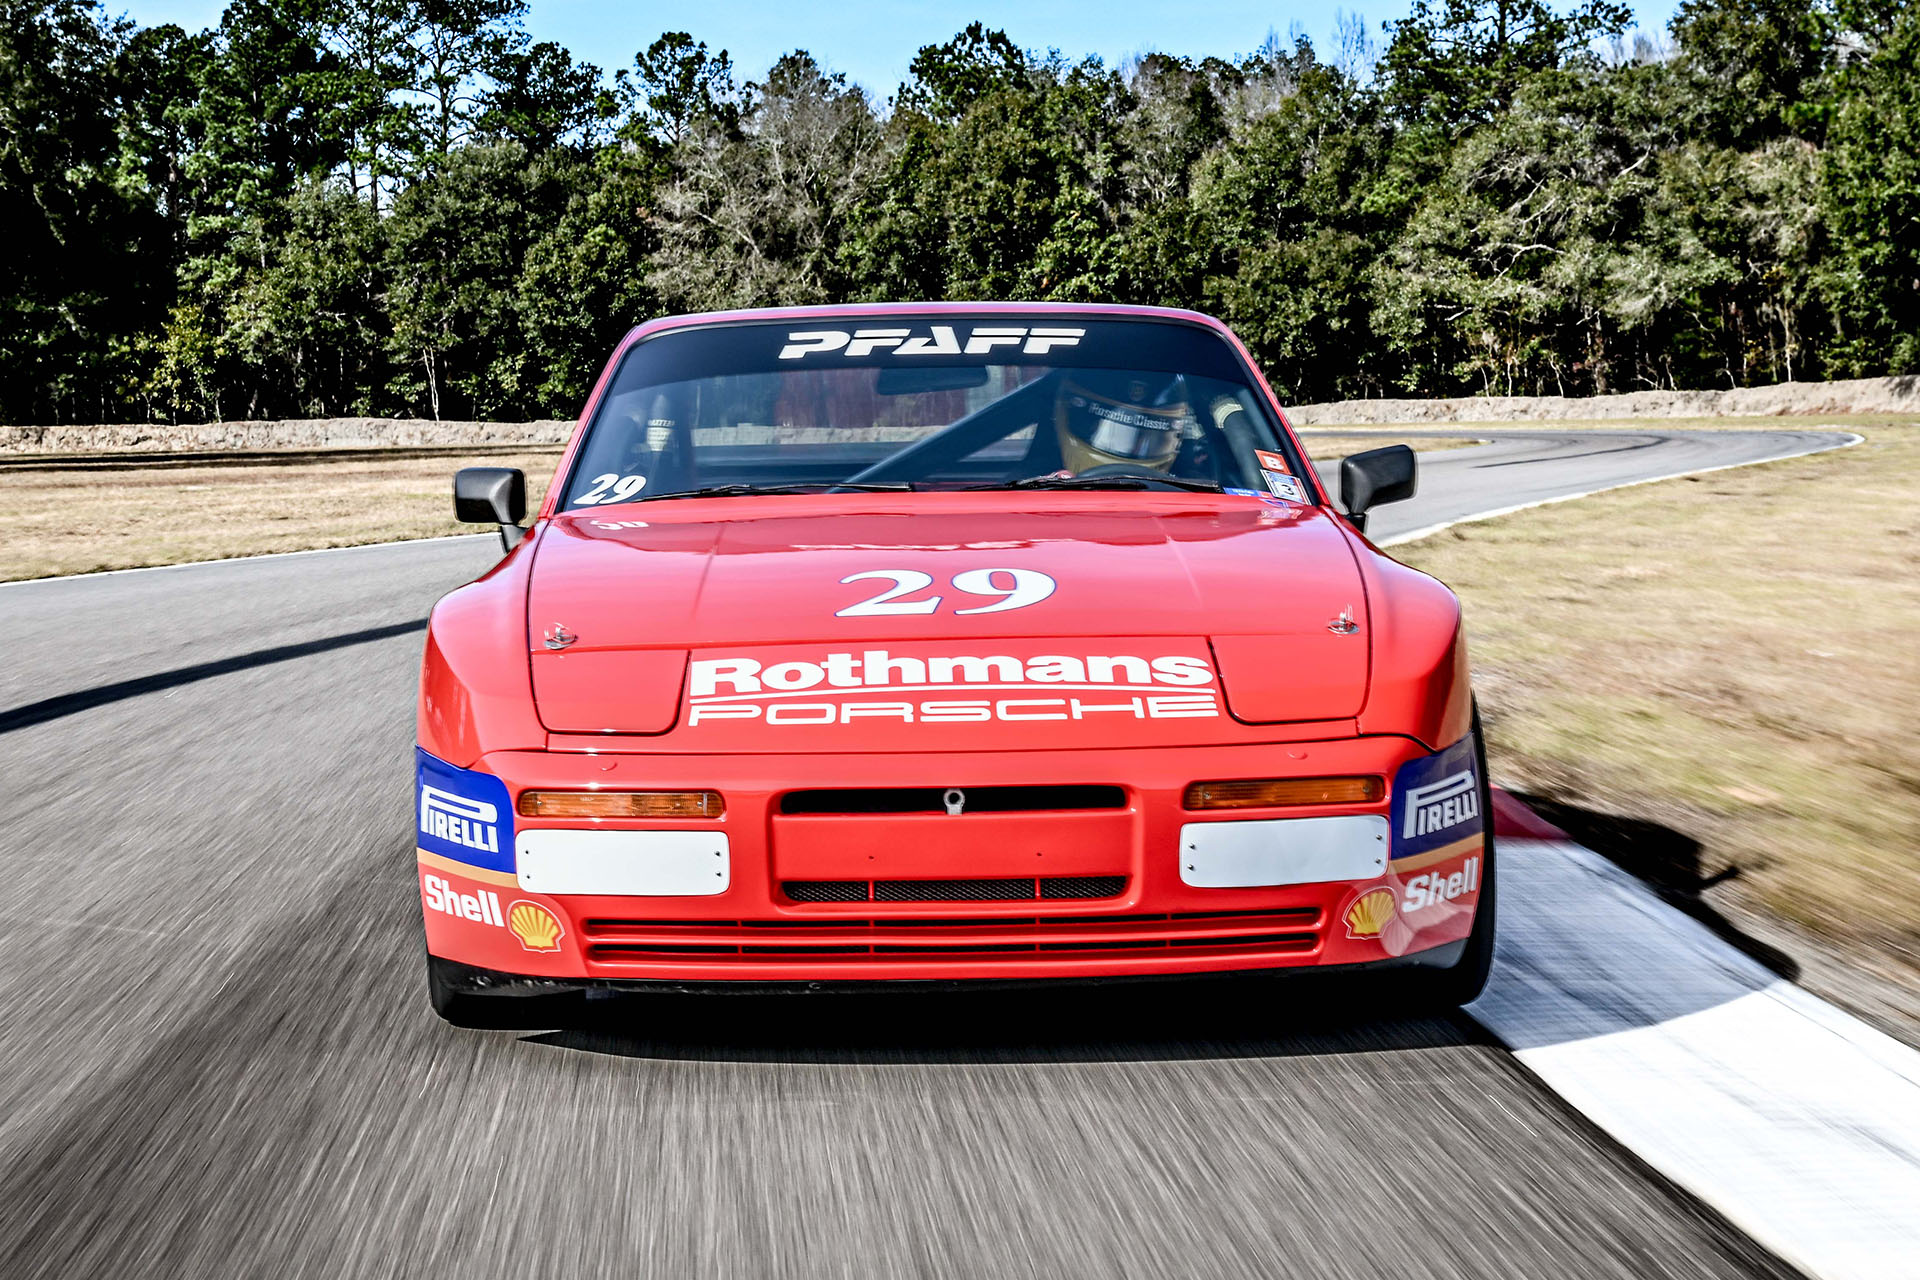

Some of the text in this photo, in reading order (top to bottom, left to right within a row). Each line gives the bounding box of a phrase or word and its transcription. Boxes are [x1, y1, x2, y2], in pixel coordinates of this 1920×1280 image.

[778, 326, 1086, 359] PFAFF
[573, 473, 647, 505] 29
[834, 568, 1057, 617] 29
[689, 650, 1215, 697] Rothmans
[688, 694, 1219, 727] PORSCHE
[420, 784, 499, 854] PIRELLI
[1402, 768, 1479, 840] PIRELLI
[424, 873, 505, 928] Shell
[1401, 856, 1479, 913] Shell
